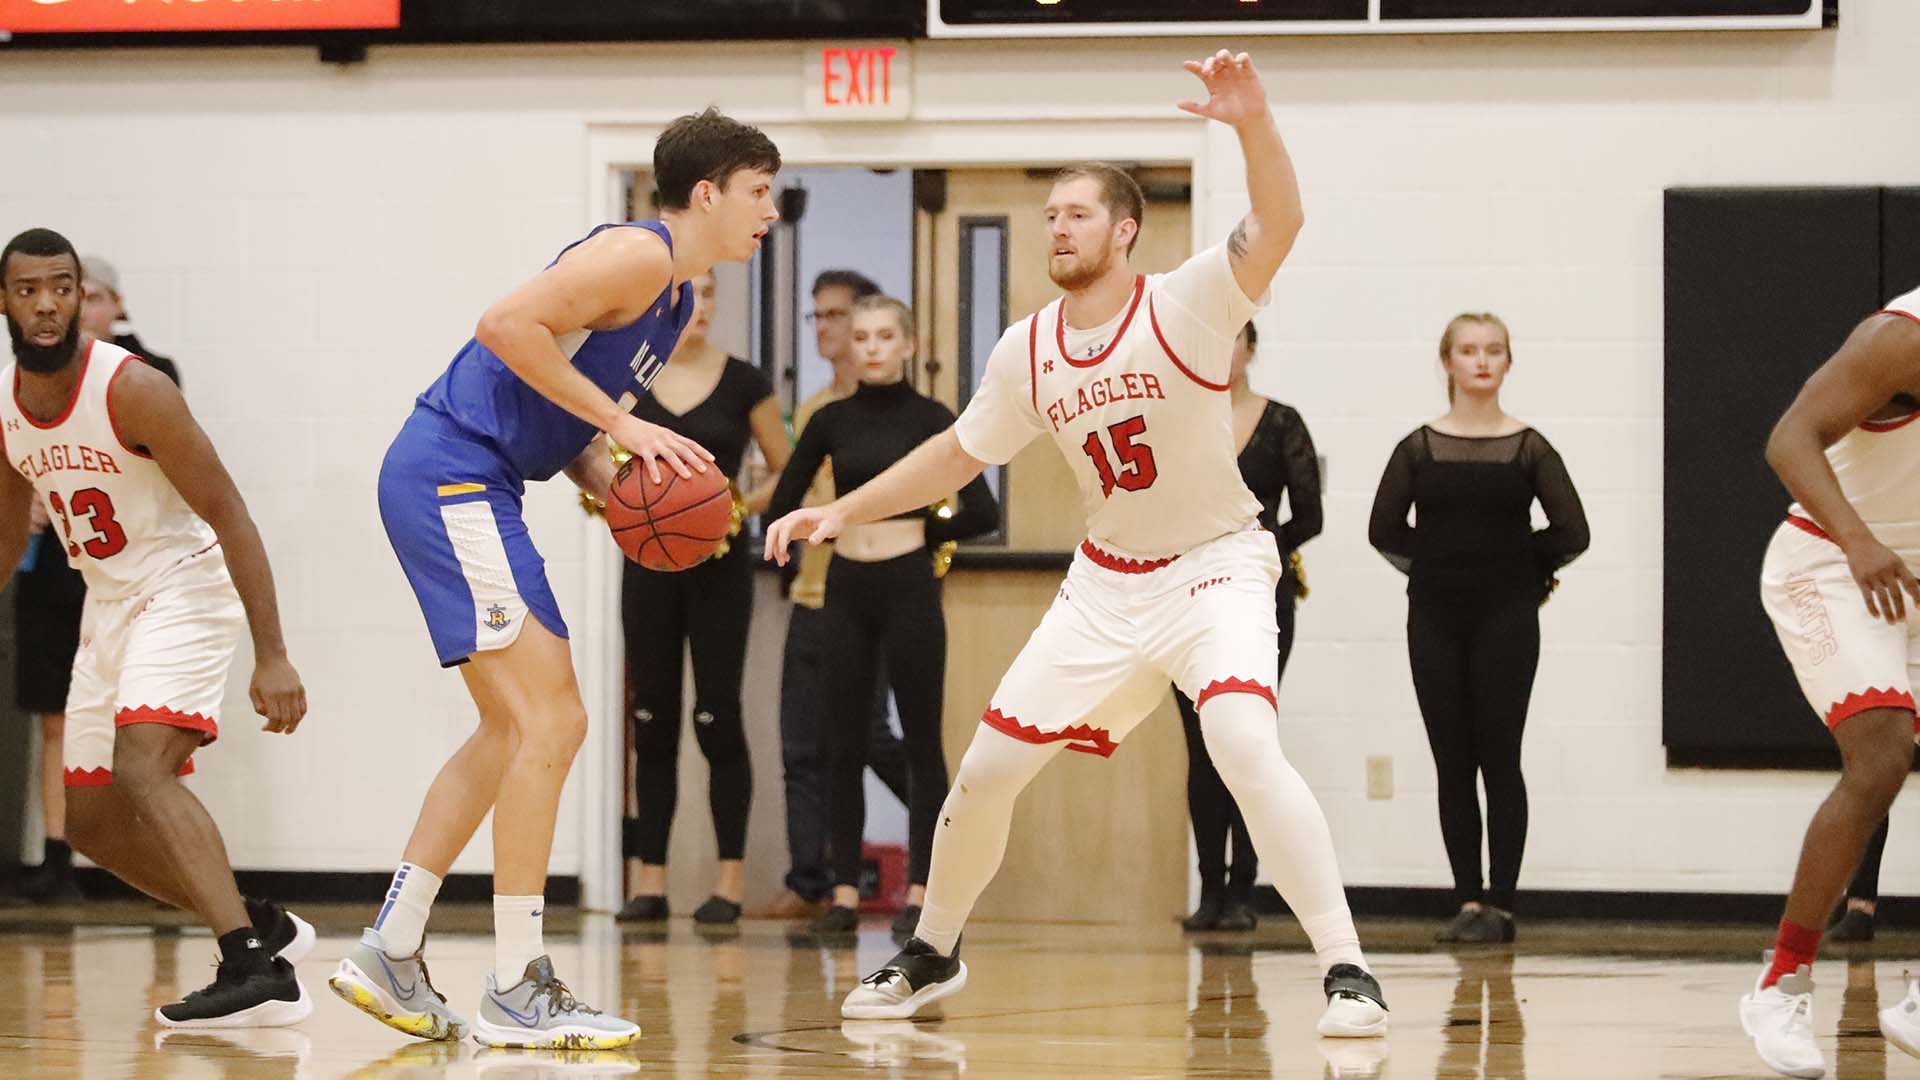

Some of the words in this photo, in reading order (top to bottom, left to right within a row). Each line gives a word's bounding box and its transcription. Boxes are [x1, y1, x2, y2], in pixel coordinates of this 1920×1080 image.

[823, 47, 897, 105] EXIT
[1047, 373, 1166, 432] FLAGLER
[18, 444, 122, 479] FLAGLER
[1082, 414, 1158, 499] 15
